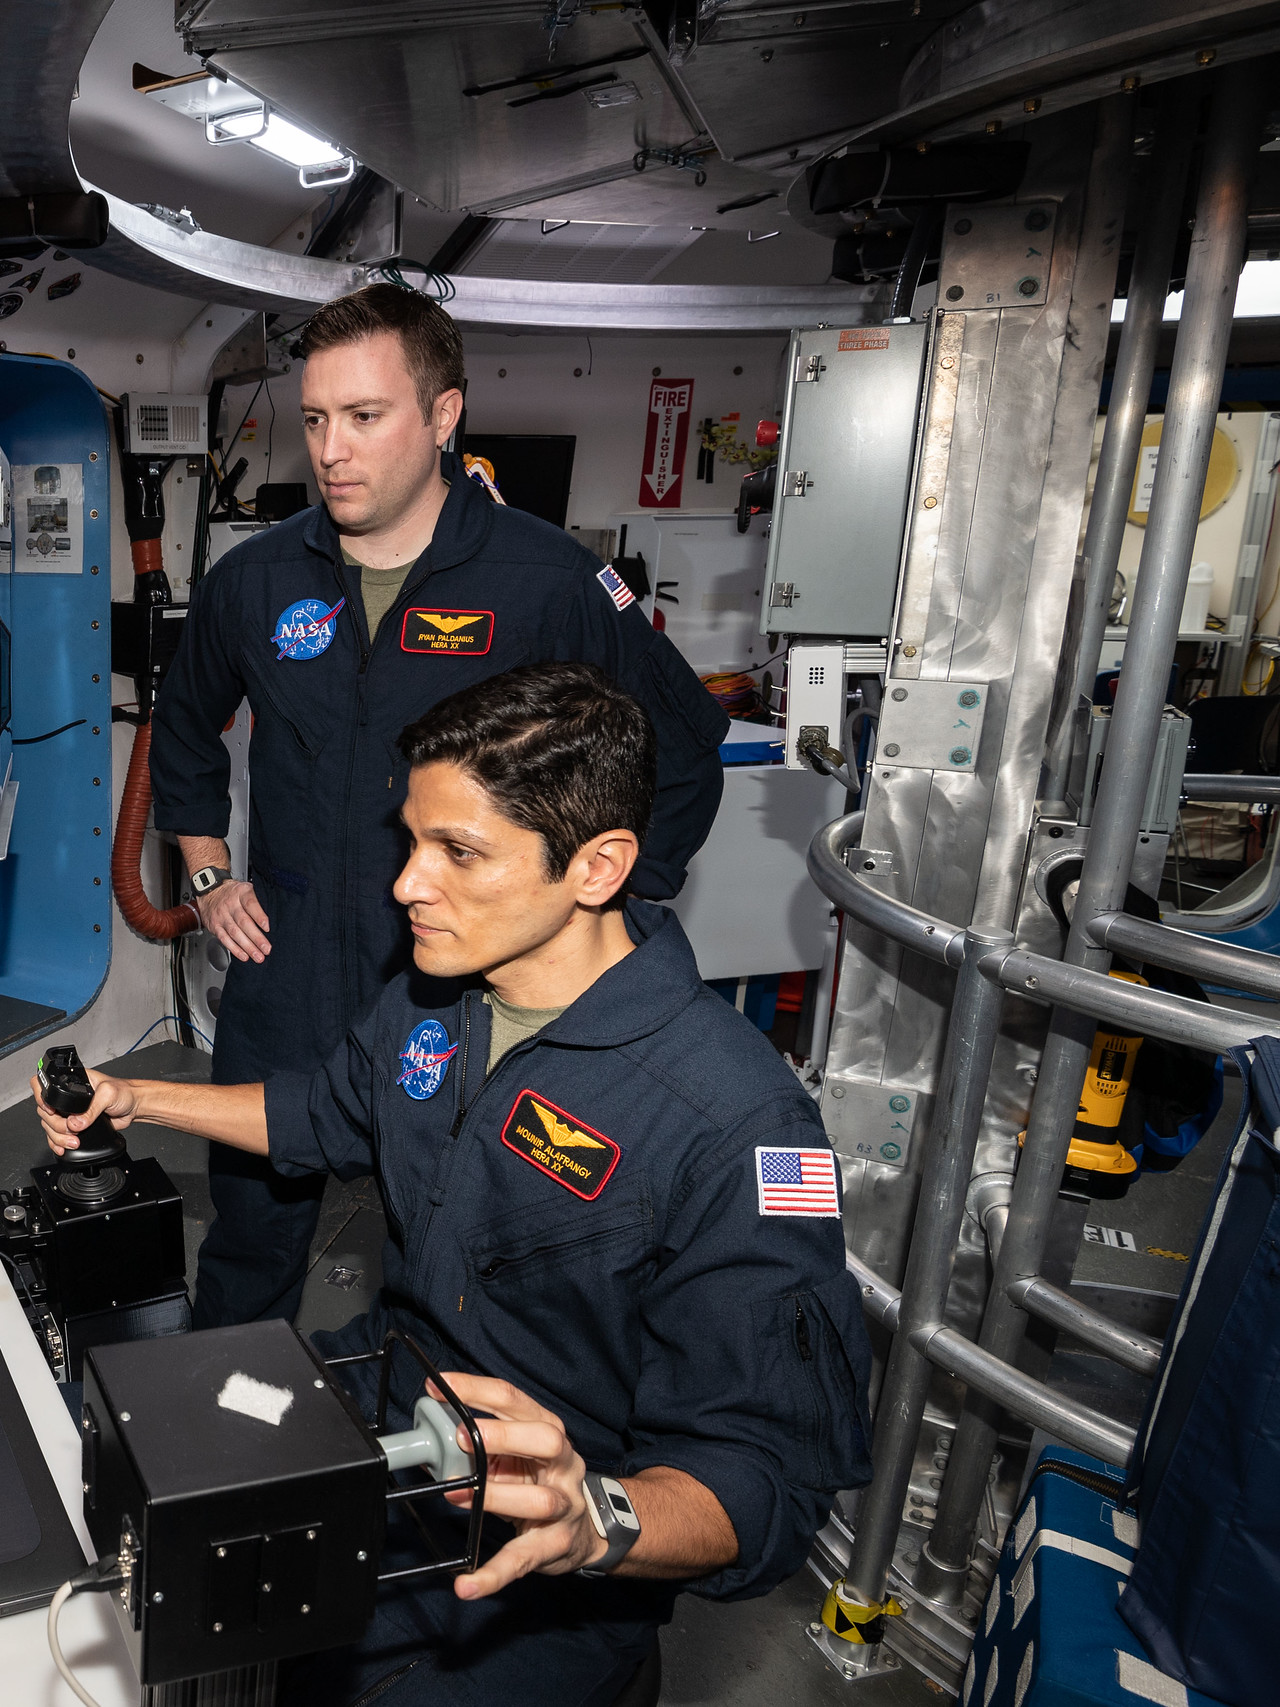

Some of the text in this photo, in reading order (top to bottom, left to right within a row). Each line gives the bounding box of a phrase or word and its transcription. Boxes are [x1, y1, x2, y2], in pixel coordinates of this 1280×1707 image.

[864, 340, 887, 348] PHASE
[652, 391, 686, 407] FIRE
[654, 408, 672, 494] EXTINGUISHER
[280, 622, 332, 640] NASA
[418, 634, 474, 643] RYAN PALDANIUS
[430, 641, 460, 650] HERA XX
[406, 1041, 442, 1082] NASA
[516, 1124, 592, 1180] MOUNIR ALAFRANGY
[530, 1147, 564, 1174] HERA XX
